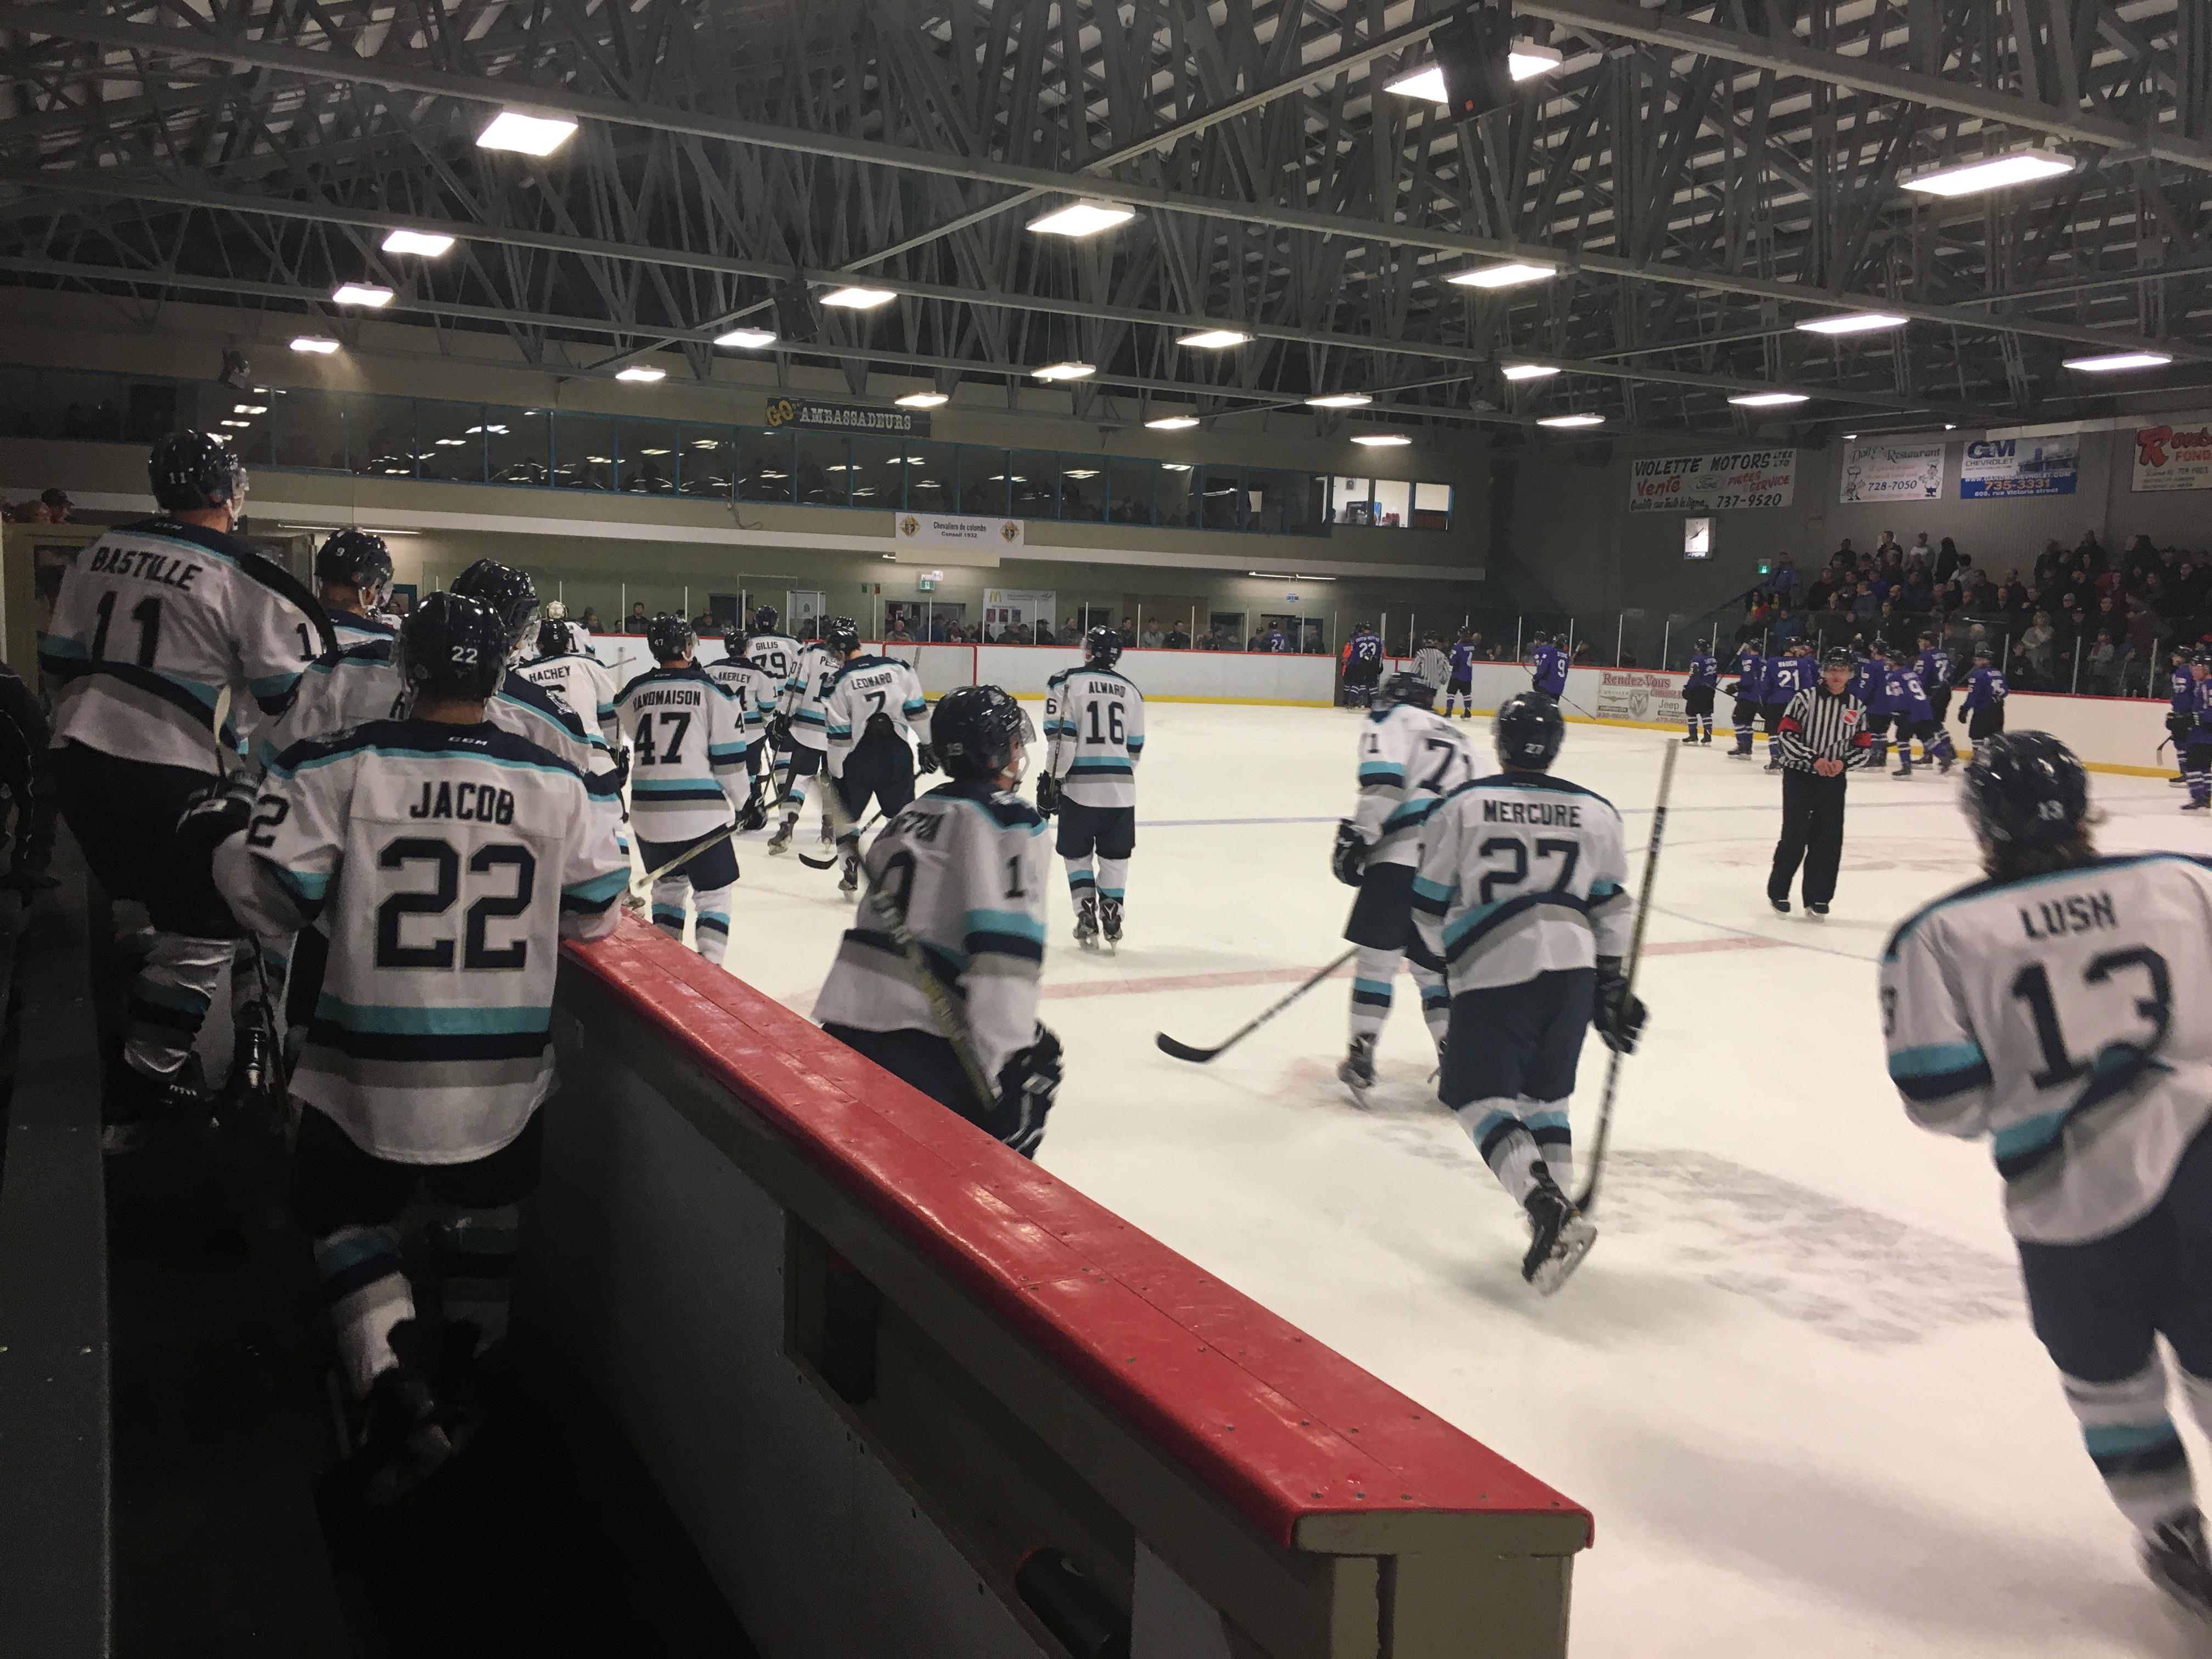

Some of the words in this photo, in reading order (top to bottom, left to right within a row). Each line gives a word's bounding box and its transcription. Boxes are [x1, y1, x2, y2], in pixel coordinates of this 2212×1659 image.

[800, 407, 911, 430] AMBASSADEURS
[1635, 458, 1703, 476] VIOLETTE
[1710, 453, 1771, 472] MOTORS
[1886, 448, 1940, 464] Restaurant
[169, 472, 187, 484] 11
[1637, 475, 1681, 496] Vente
[1749, 475, 1791, 492] SERVICE
[1868, 480, 1917, 492] 728-7050
[1985, 479, 2051, 490] 735-3331
[1716, 494, 1782, 508] 737-9520
[933, 521, 959, 531] Chevaliers
[91, 547, 203, 592] BASTILLE
[92, 591, 162, 669] 11
[452, 646, 478, 664] 22
[755, 641, 778, 651] GILLIS
[528, 665, 571, 683] HACHEY
[751, 652, 787, 679] 79
[851, 672, 892, 691] LEONARD
[1089, 681, 1126, 698] ALWARD
[1602, 672, 1671, 689] Rendez-Vous
[1778, 670, 1799, 690] 21
[1907, 680, 1927, 701] 9
[864, 691, 886, 714] 7
[1046, 698, 1057, 714] 6
[1658, 699, 1679, 711] Jeep
[734, 713, 745, 734] 4
[1086, 701, 1124, 745] 16
[635, 712, 691, 765] 47
[410, 781, 515, 825] JACOB
[1483, 799, 1582, 828] MERCURE
[1479, 837, 1579, 904] 27
[375, 836, 536, 971] 22
[2017, 890, 2119, 940] LUSH
[2011, 943, 2171, 1090] 13
